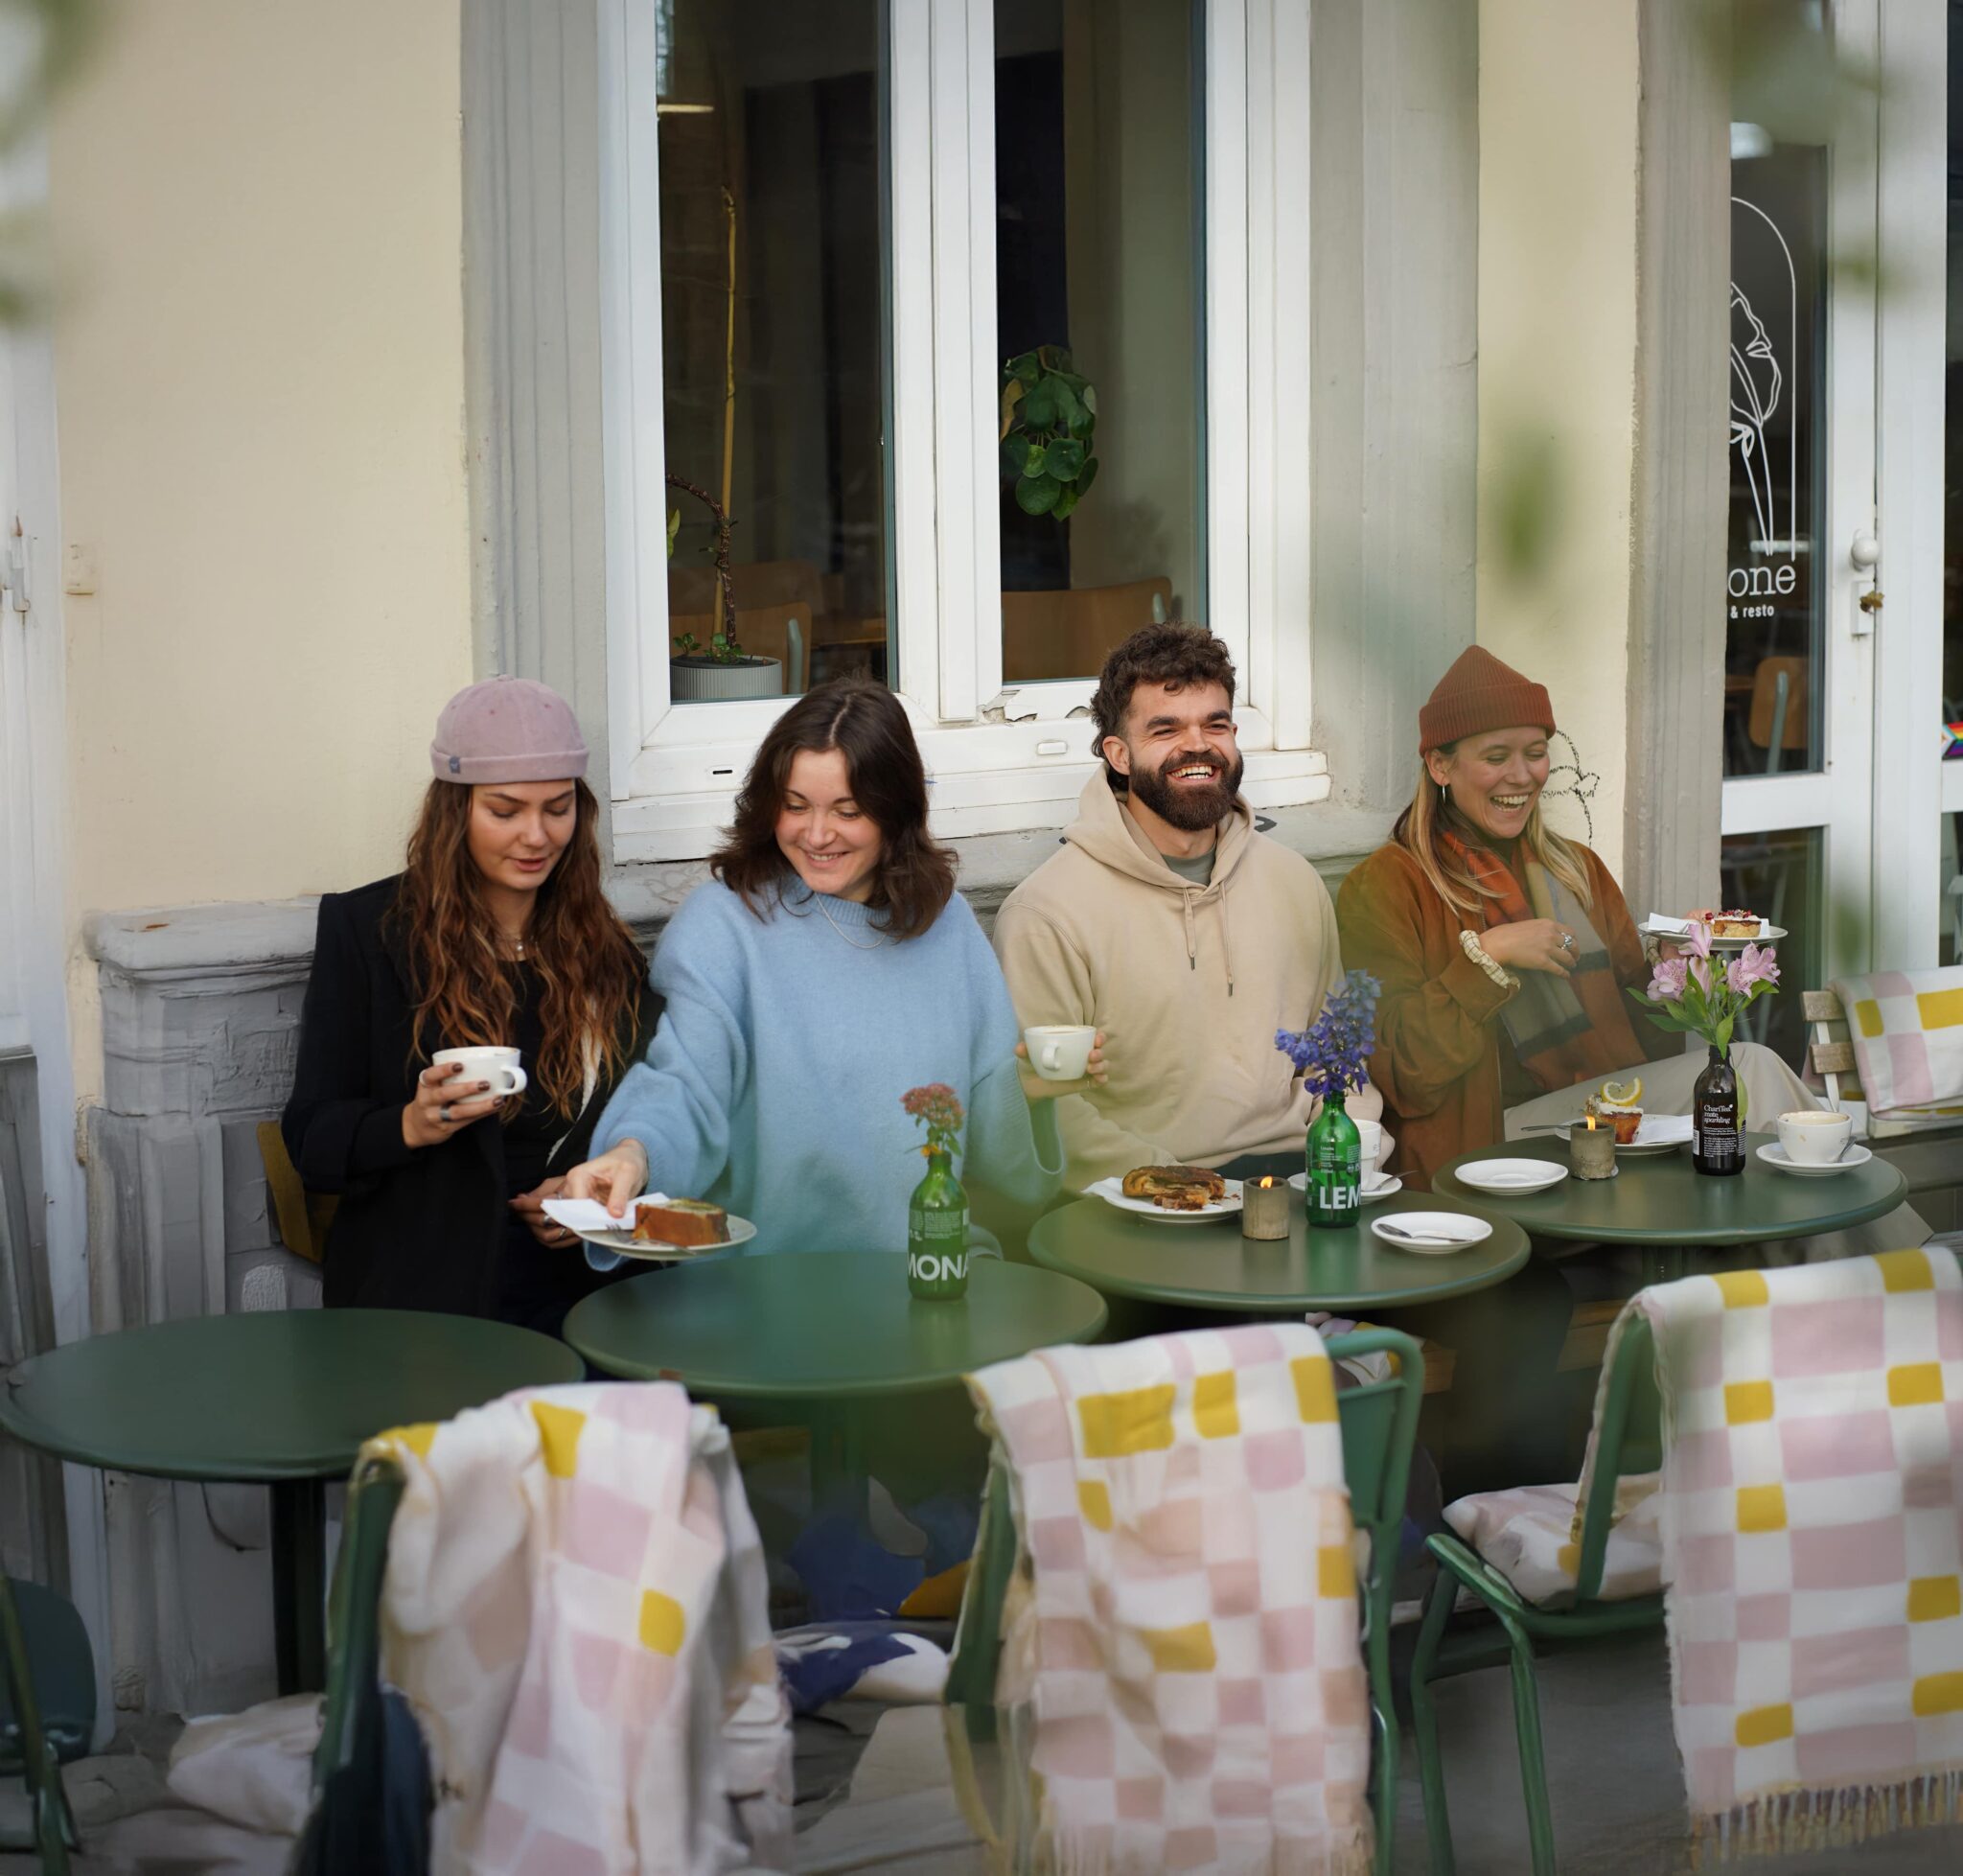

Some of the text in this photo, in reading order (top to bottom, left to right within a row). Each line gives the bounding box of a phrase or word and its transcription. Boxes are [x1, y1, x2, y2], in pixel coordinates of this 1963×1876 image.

[1730, 604, 1775, 619] & resto
[1703, 1116, 1731, 1124] sparkling
